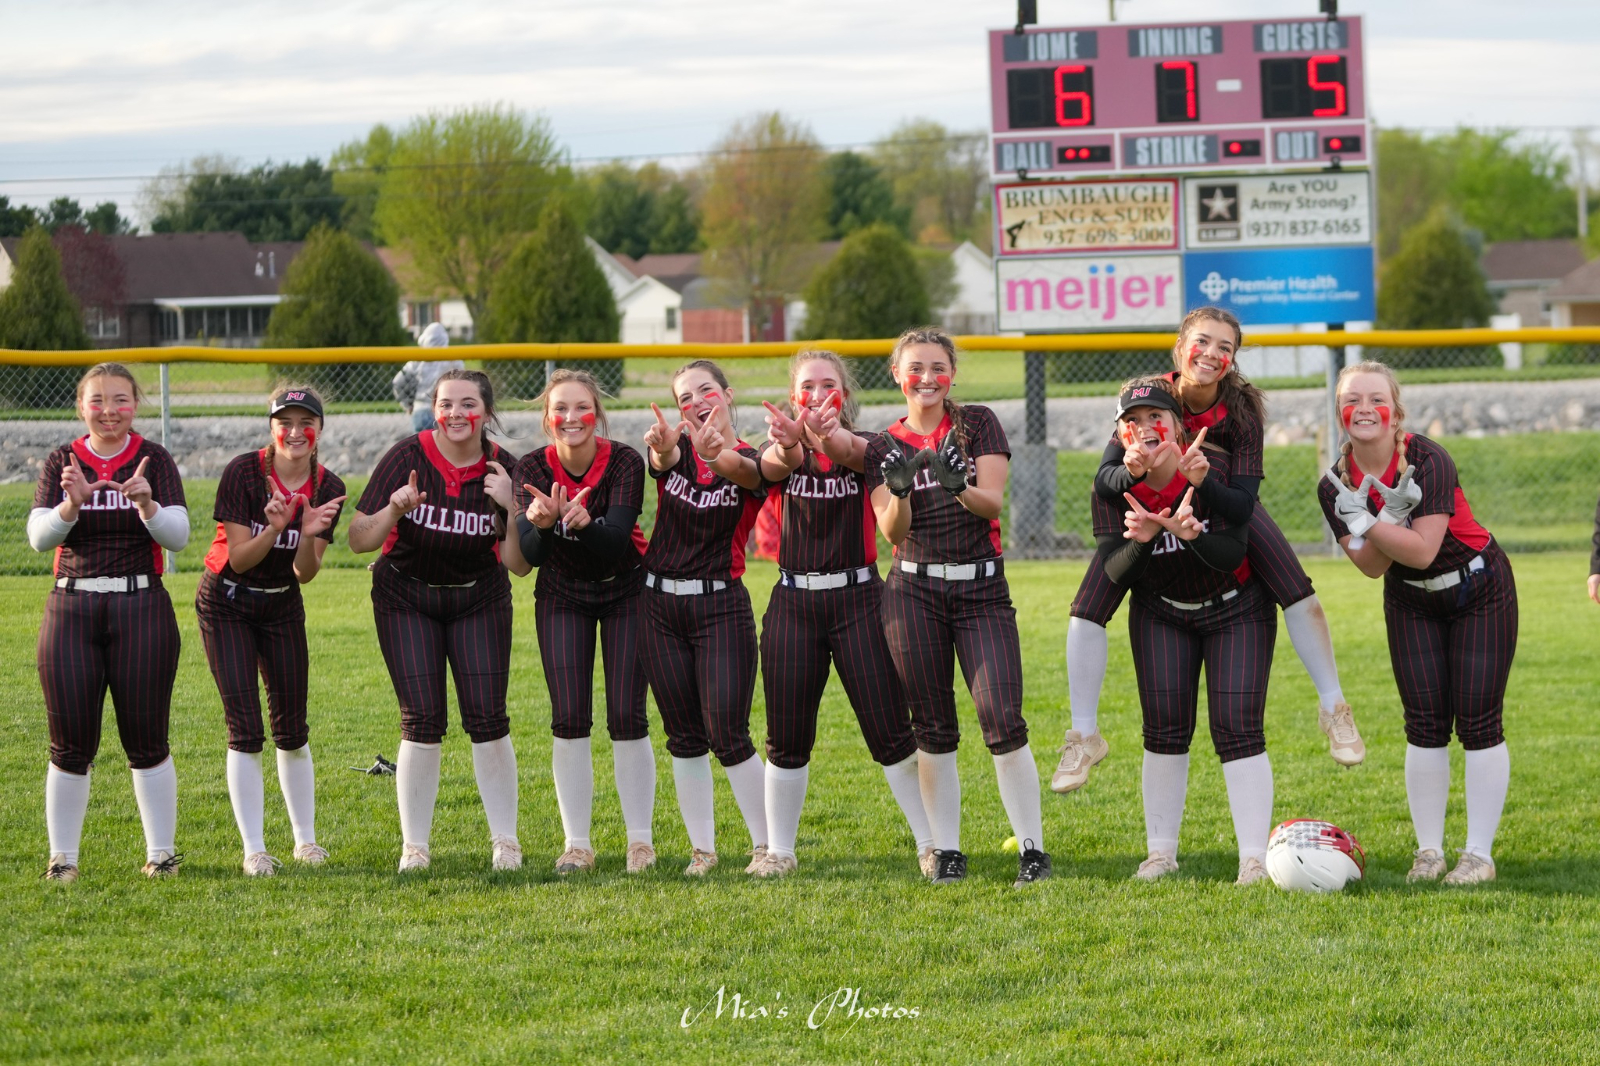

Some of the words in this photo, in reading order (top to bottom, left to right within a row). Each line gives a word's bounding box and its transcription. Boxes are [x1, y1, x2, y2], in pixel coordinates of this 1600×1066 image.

[1138, 26, 1213, 57] INNING
[1261, 20, 1341, 52] GUESTS
[1054, 65, 1091, 126] 6
[1162, 61, 1196, 119] 7
[1307, 55, 1346, 117] 5
[1001, 141, 1050, 171] BALL
[1135, 134, 1210, 166] STRIKE
[1276, 131, 1316, 160] OUT
[1005, 185, 1170, 209] BRUMBAUGH
[1267, 180, 1296, 194] Are
[1301, 179, 1338, 193] YOU
[1038, 209, 1086, 226] ENG
[1090, 208, 1113, 224] &
[1116, 206, 1172, 223] SURV
[1249, 197, 1291, 213] Army
[1296, 194, 1357, 212] Strong?
[1044, 226, 1172, 246] 937-698-3000
[1005, 264, 1175, 320] meijer
[1230, 277, 1286, 293] Premier
[1288, 275, 1338, 291] Health
[286, 392, 306, 401] MU
[1131, 387, 1152, 399] MU
[665, 470, 739, 508] BULLDOGS
